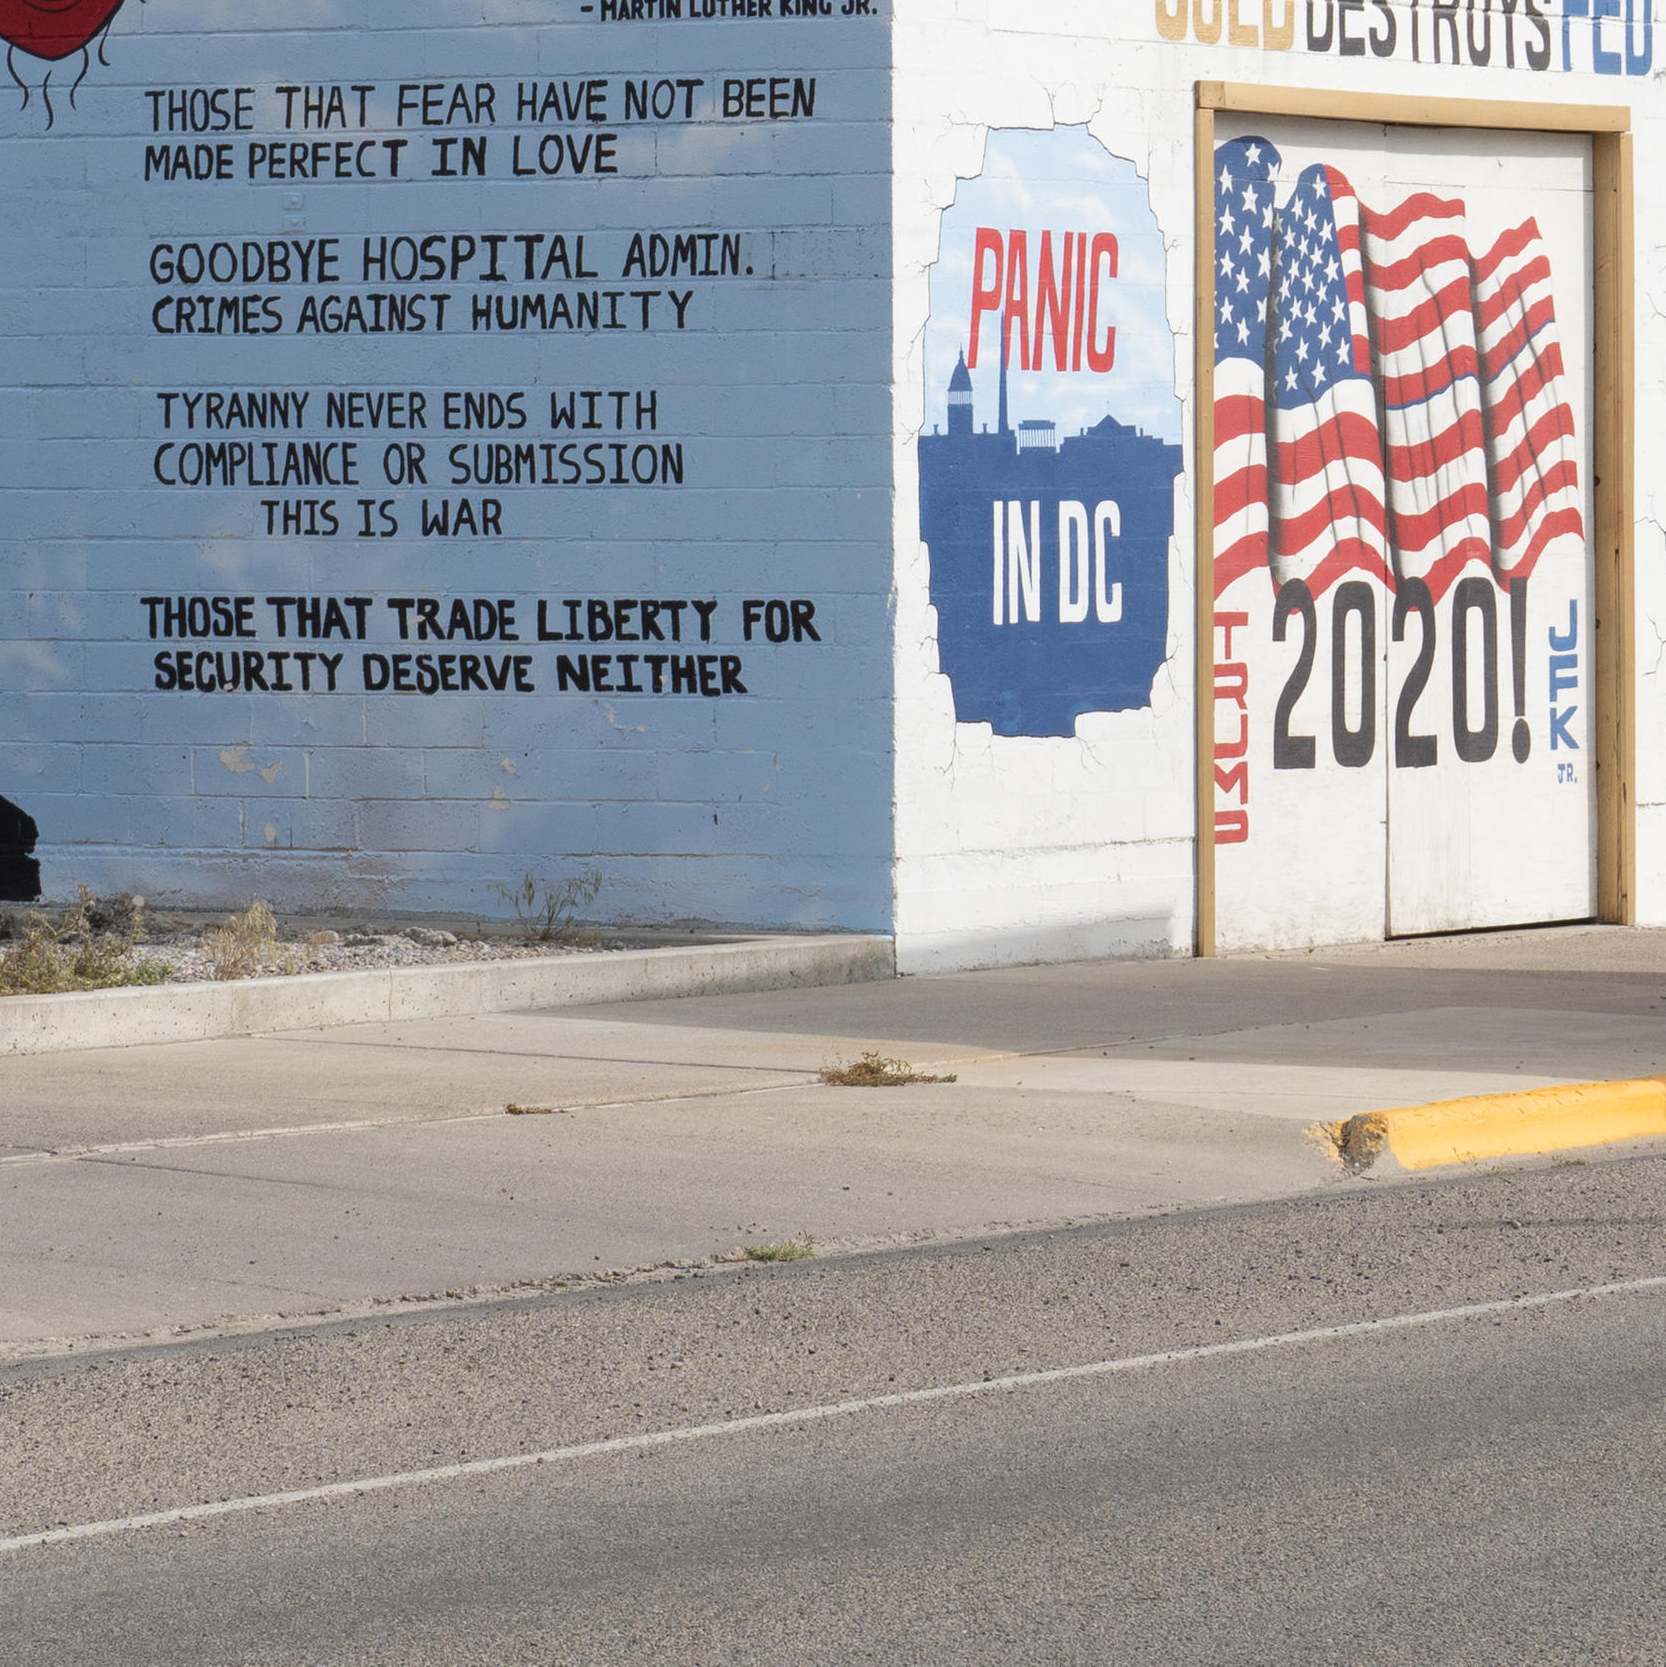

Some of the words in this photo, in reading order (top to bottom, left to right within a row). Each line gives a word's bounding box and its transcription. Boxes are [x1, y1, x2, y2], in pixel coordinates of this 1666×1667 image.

[144, 87, 256, 132] THOSE
[275, 85, 376, 130] THAT
[397, 82, 496, 127] FEAR
[517, 79, 609, 124] HAVE
[625, 78, 705, 120] NOT
[722, 77, 816, 120] BEEN
[144, 143, 234, 182] MADE
[248, 138, 408, 179] PERFECT
[431, 136, 487, 177] IN
[512, 133, 618, 177] LOVE
[149, 238, 340, 285] GOODBYE
[363, 233, 599, 282] HOSPITAL
[621, 232, 754, 278] ADMIN.
[152, 293, 283, 335] CRIMES
[296, 293, 452, 334] AGAINST
[472, 290, 694, 331] HUMANITY
[967, 226, 1119, 374] PANIC
[156, 391, 310, 430] TYRANNY
[326, 391, 427, 430] NEVER
[443, 391, 527, 430] ENDS
[550, 389, 657, 430] WITH
[153, 441, 360, 487] COMPLIANCE
[383, 442, 428, 486] OR
[448, 443, 684, 485] SUBMISSION
[260, 499, 340, 536] THIS
[357, 499, 398, 538] IS
[421, 498, 503, 537] WAR
[992, 499, 1041, 626] IN
[1058, 499, 1123, 624] DC
[140, 595, 257, 640] THOSE
[265, 596, 374, 640] THAT
[387, 597, 520, 642] TRADE
[537, 598, 718, 644] LIBERTY
[742, 599, 822, 644] FOR
[154, 650, 344, 693] SECURITY
[362, 652, 535, 696] DESERVE
[556, 653, 748, 698] NEITHER
[1272, 576, 1531, 769] 2020!
[1548, 599, 1579, 751] JFK
[1558, 762, 1578, 784] JR.
